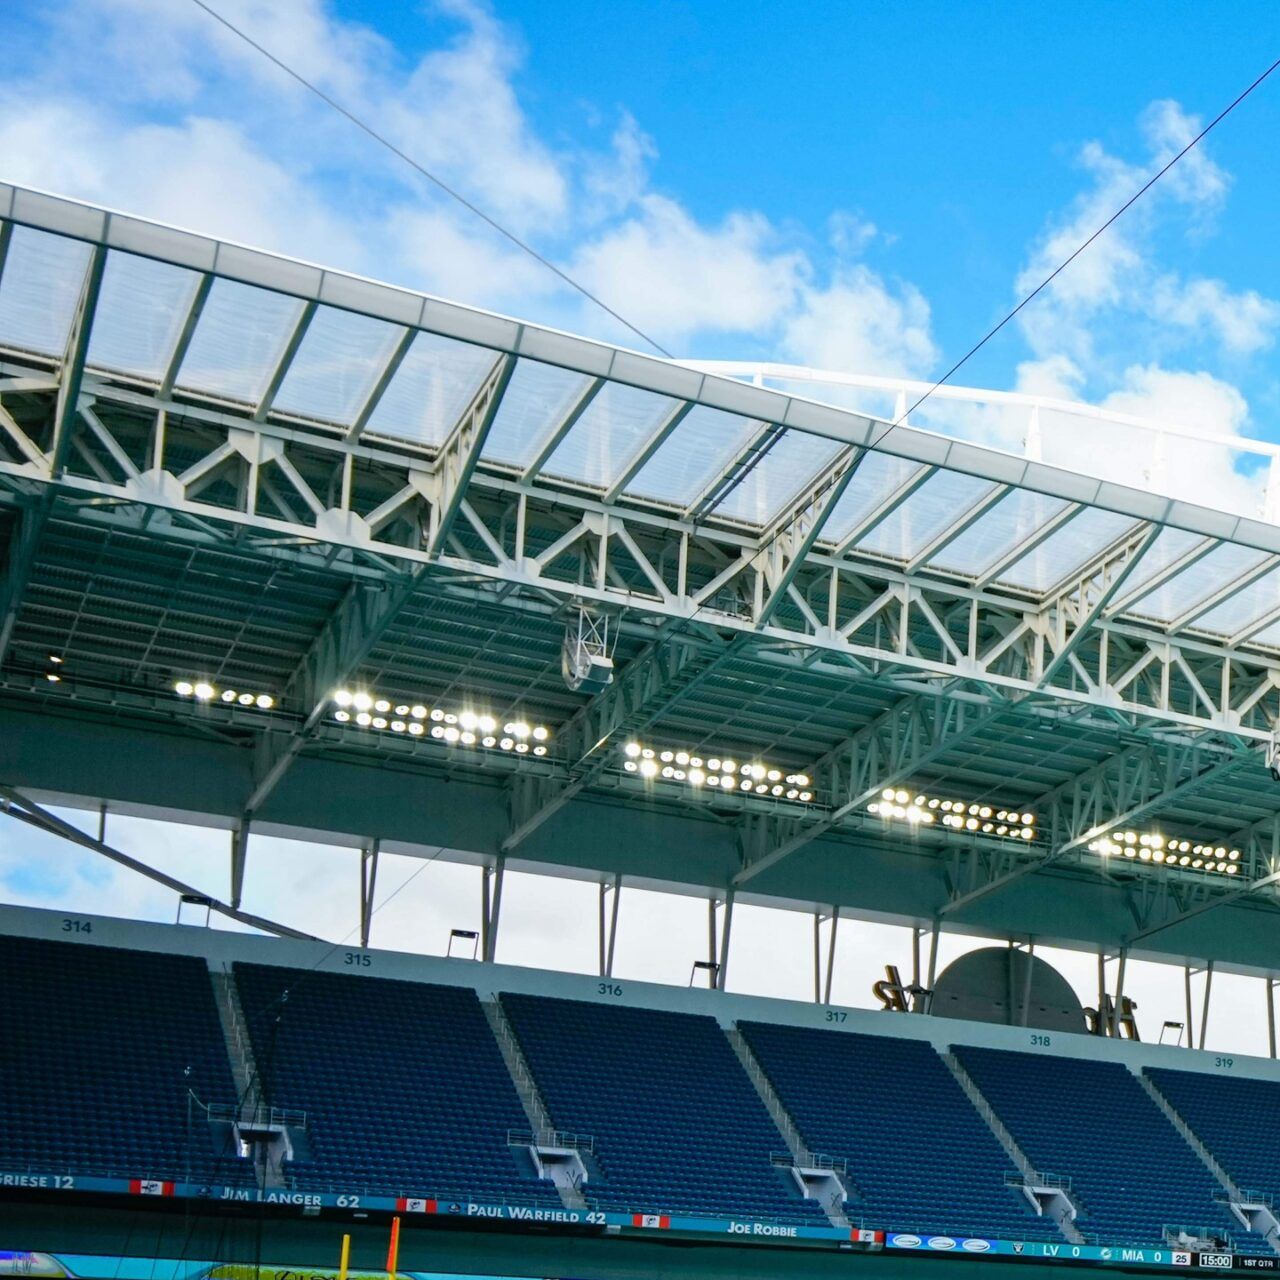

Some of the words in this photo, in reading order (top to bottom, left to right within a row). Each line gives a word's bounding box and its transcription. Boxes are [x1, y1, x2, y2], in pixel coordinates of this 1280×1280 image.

[62, 919, 92, 934] 314
[344, 952, 372, 966] 315
[598, 983, 623, 997] 316
[826, 1010, 847, 1023] 317
[1030, 1034, 1050, 1047] 318
[1216, 1057, 1233, 1068] 319
[54, 1176, 74, 1189] 12
[221, 1186, 249, 1201] JIM
[257, 1190, 321, 1206] LANGER
[336, 1196, 360, 1208] 62
[468, 1204, 504, 1217] PAUL
[508, 1206, 579, 1223] WARFIELD
[586, 1212, 606, 1224] 42
[728, 1222, 751, 1234] JOE
[753, 1223, 797, 1237] ROBBIE
[1043, 1245, 1059, 1257] LV
[1072, 1246, 1080, 1257] 0
[1122, 1251, 1144, 1262] MIA
[1154, 1252, 1162, 1262] 0
[1176, 1255, 1187, 1263] 25
[1203, 1256, 1230, 1266] 15:00
